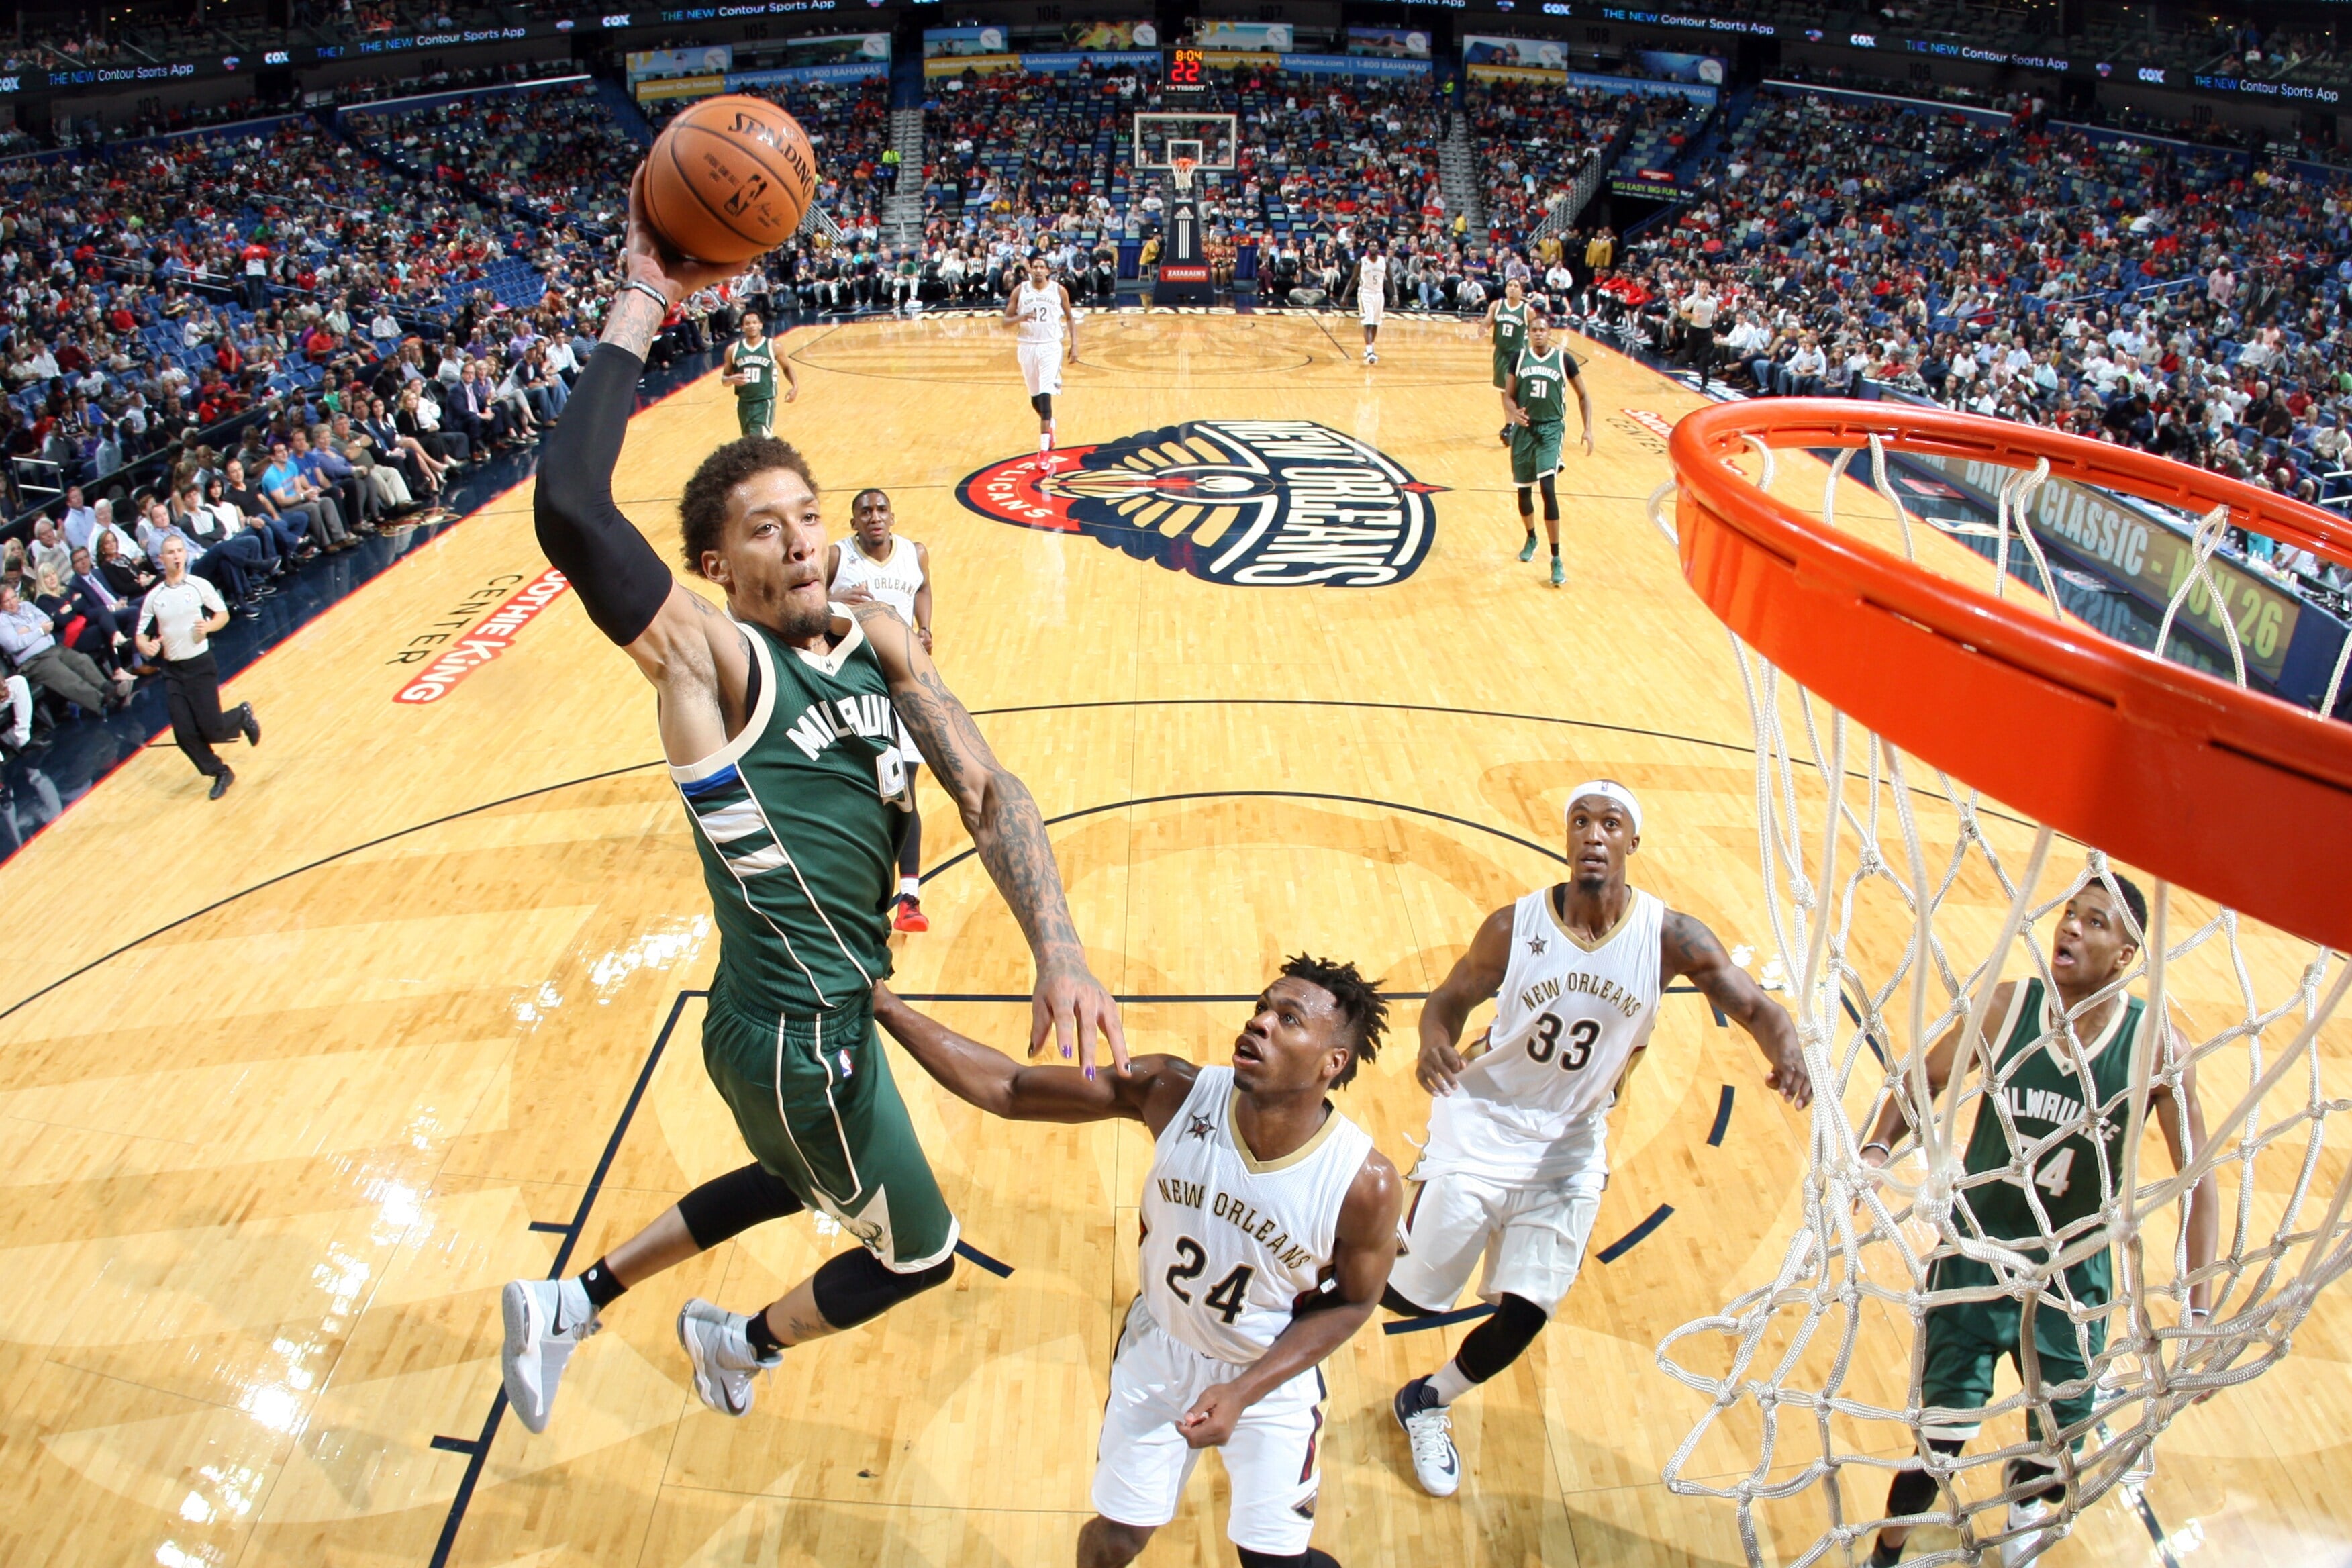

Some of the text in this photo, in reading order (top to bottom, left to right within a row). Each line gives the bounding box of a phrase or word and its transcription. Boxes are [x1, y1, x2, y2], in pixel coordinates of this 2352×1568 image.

[661, 0, 835, 21] THE NEW Contour Sports App
[1037, 6, 1061, 21] 106
[1543, 3, 1571, 15] COX
[603, 14, 631, 27] COX
[744, 23, 768, 39] 105
[1603, 8, 1775, 36] THE NEW Contour Sports App
[360, 26, 526, 53] THE NEW Contour Sports App
[1850, 34, 1875, 47] COX
[264, 51, 289, 64] COX
[1176, 50, 1202, 62] 8:04
[1285, 57, 1345, 67] bahamas.com
[1381, 62, 1427, 71] BAHAMAS
[1906, 40, 2069, 70] THE NEW Contour Sports App
[49, 64, 194, 85] THE NEW Contour Sports App
[730, 72, 793, 86] bahamas.com
[832, 66, 881, 77] BAHAMAS
[1171, 62, 1201, 81] 22
[2138, 68, 2165, 83] COX
[2195, 75, 2339, 103] THE NEW Contour Sports App
[728, 111, 815, 199] SPALDING
[1502, 323, 1514, 337] 13
[743, 367, 761, 383] 20
[1520, 365, 1561, 382] MILWAUKEE
[1530, 379, 1548, 398] 31
[1206, 420, 1367, 462] NEW
[1232, 467, 1404, 585] ORLEANS
[2039, 479, 2148, 576] CLASSIC
[2167, 548, 2237, 629] NOV
[2237, 588, 2283, 659] 26
[474, 569, 567, 636] OOTHIE
[385, 575, 524, 665] CENTER
[1522, 971, 1643, 1018] NEW ORLEANS
[1525, 1010, 1604, 1073] 33
[1157, 1178, 1312, 1270] NEW ORLEANS
[1165, 1234, 1257, 1327] 24
